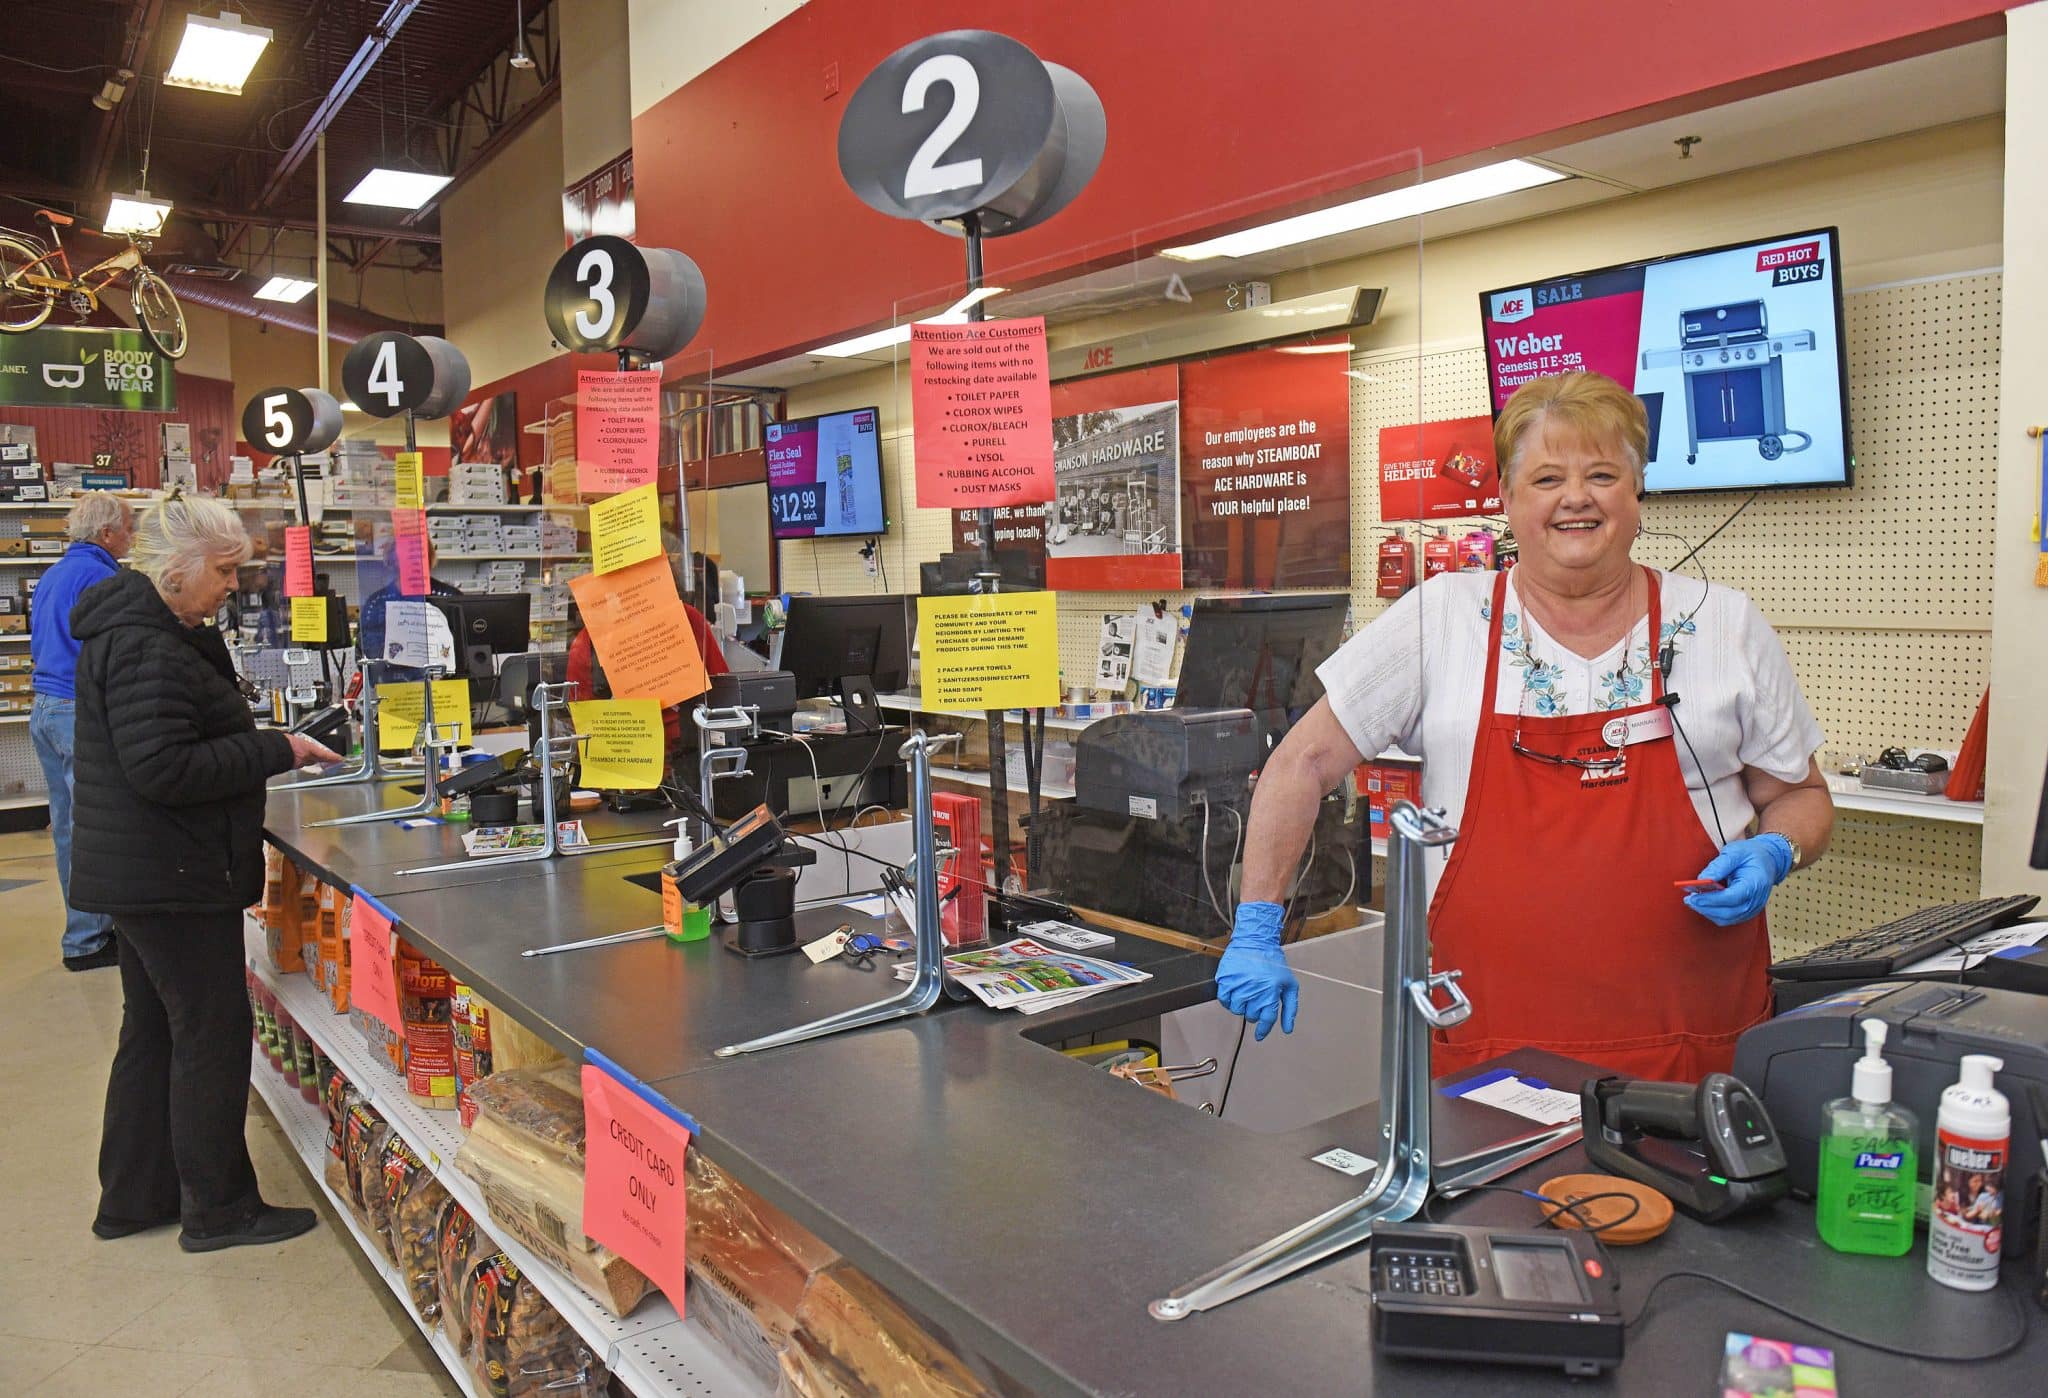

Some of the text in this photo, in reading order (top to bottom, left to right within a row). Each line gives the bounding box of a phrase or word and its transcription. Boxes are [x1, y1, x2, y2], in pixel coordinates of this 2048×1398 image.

[902, 54, 983, 199] 2
[1762, 248, 1812, 266] RED HOT
[1779, 265, 1819, 282] BUYS
[575, 249, 616, 339] 3
[1538, 284, 1582, 305] SALE
[1500, 300, 1523, 315] ACE
[913, 325, 1042, 340] Attention Ace Customers
[929, 347, 944, 355] We
[964, 345, 982, 354] sold
[985, 345, 1000, 353] out
[1004, 343, 1013, 352] of
[1015, 343, 1029, 351] the
[1496, 333, 1563, 358] Weber
[104, 349, 153, 363] BOODY
[1083, 347, 1113, 370] ACE
[1498, 353, 1581, 374] Genesis II E-325
[104, 363, 153, 380] ECO
[927, 362, 968, 371] following
[971, 360, 997, 368] items
[999, 359, 1019, 367] with
[368, 342, 404, 407] 4
[581, 375, 614, 383] Attention
[924, 372, 1037, 385] restocking date available
[1499, 372, 1537, 387] Natural
[105, 379, 153, 392] WEAR
[956, 391, 1019, 401] TOILET PAPER
[954, 406, 1023, 416] CLOROX WIPES
[264, 394, 293, 448] 5
[950, 421, 1028, 433] CLOROX/BLEACH
[1206, 420, 1316, 445] Our employees are the
[769, 446, 801, 461] Flex Seal
[1092, 431, 1164, 465] HARDWARE
[96, 455, 111, 466] 37
[976, 453, 1004, 462] LYSOL
[1203, 444, 1321, 469] reason why STEAMBOAT
[947, 468, 1034, 478] RUBBING ALCOHOL
[1384, 467, 1436, 482] HELPFUL
[961, 483, 1021, 493] DUST MASKS
[1215, 471, 1306, 492] ACE HARDWARE is
[1212, 496, 1310, 516] YOUR helpful place!
[1483, 498, 1500, 508] ACE
[804, 511, 817, 520] each
[961, 510, 971, 521] ACE
[1014, 509, 1024, 518] we
[1026, 505, 1046, 517] thank
[964, 532, 974, 543] you
[1016, 526, 1041, 540] locally.
[1581, 755, 1626, 781] ACE
[1581, 776, 1629, 789] Hardware
[610, 1118, 675, 1187] CREDIT CARD
[1950, 1149, 1992, 1169] weber
[1859, 1153, 1900, 1168] Purell
[629, 1175, 657, 1214] ONLY
